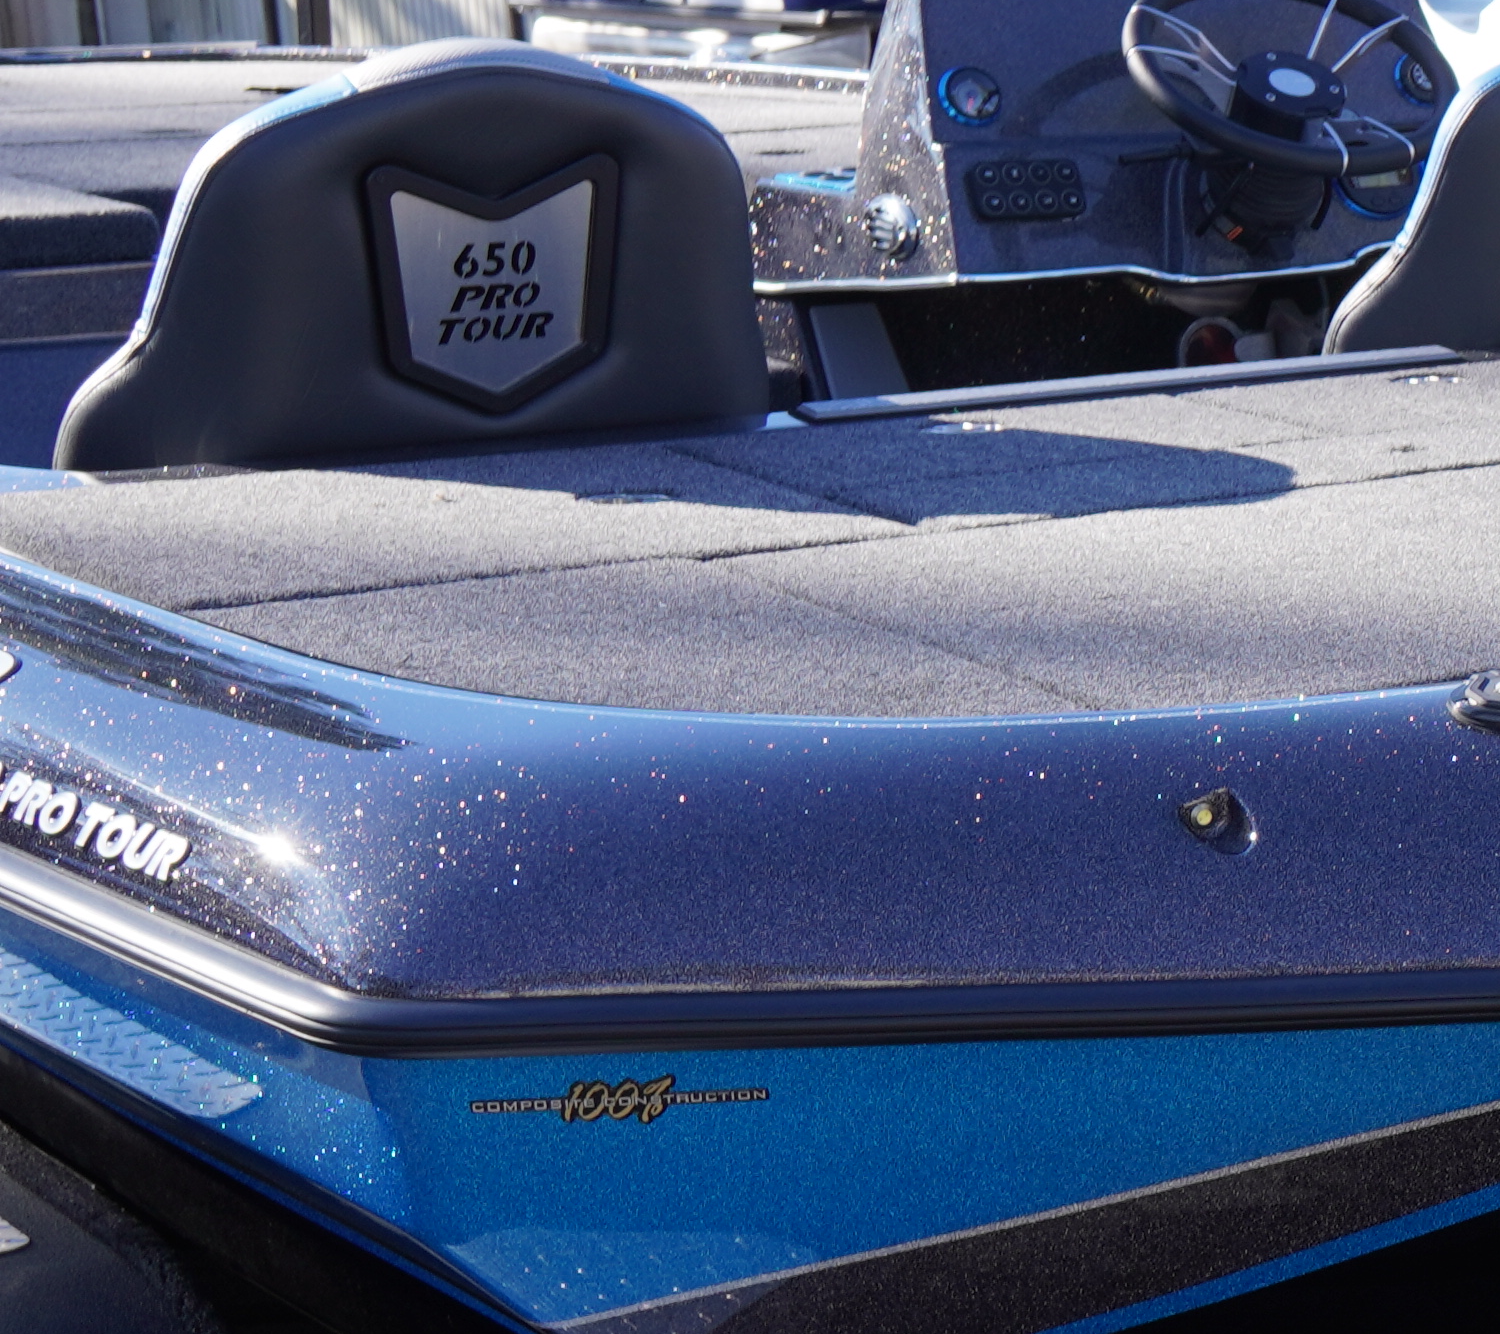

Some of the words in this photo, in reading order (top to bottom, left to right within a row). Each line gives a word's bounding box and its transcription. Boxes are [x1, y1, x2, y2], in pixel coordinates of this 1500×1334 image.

[453, 240, 536, 279] 650
[450, 281, 541, 313] PRO
[438, 312, 554, 346] TOUR
[0, 770, 80, 835] PRO
[75, 802, 191, 882] TOUR
[471, 1097, 595, 1113] COMPOSITE
[604, 1087, 768, 1107] CONSTRUCTION
[564, 1076, 673, 1123] 100%
